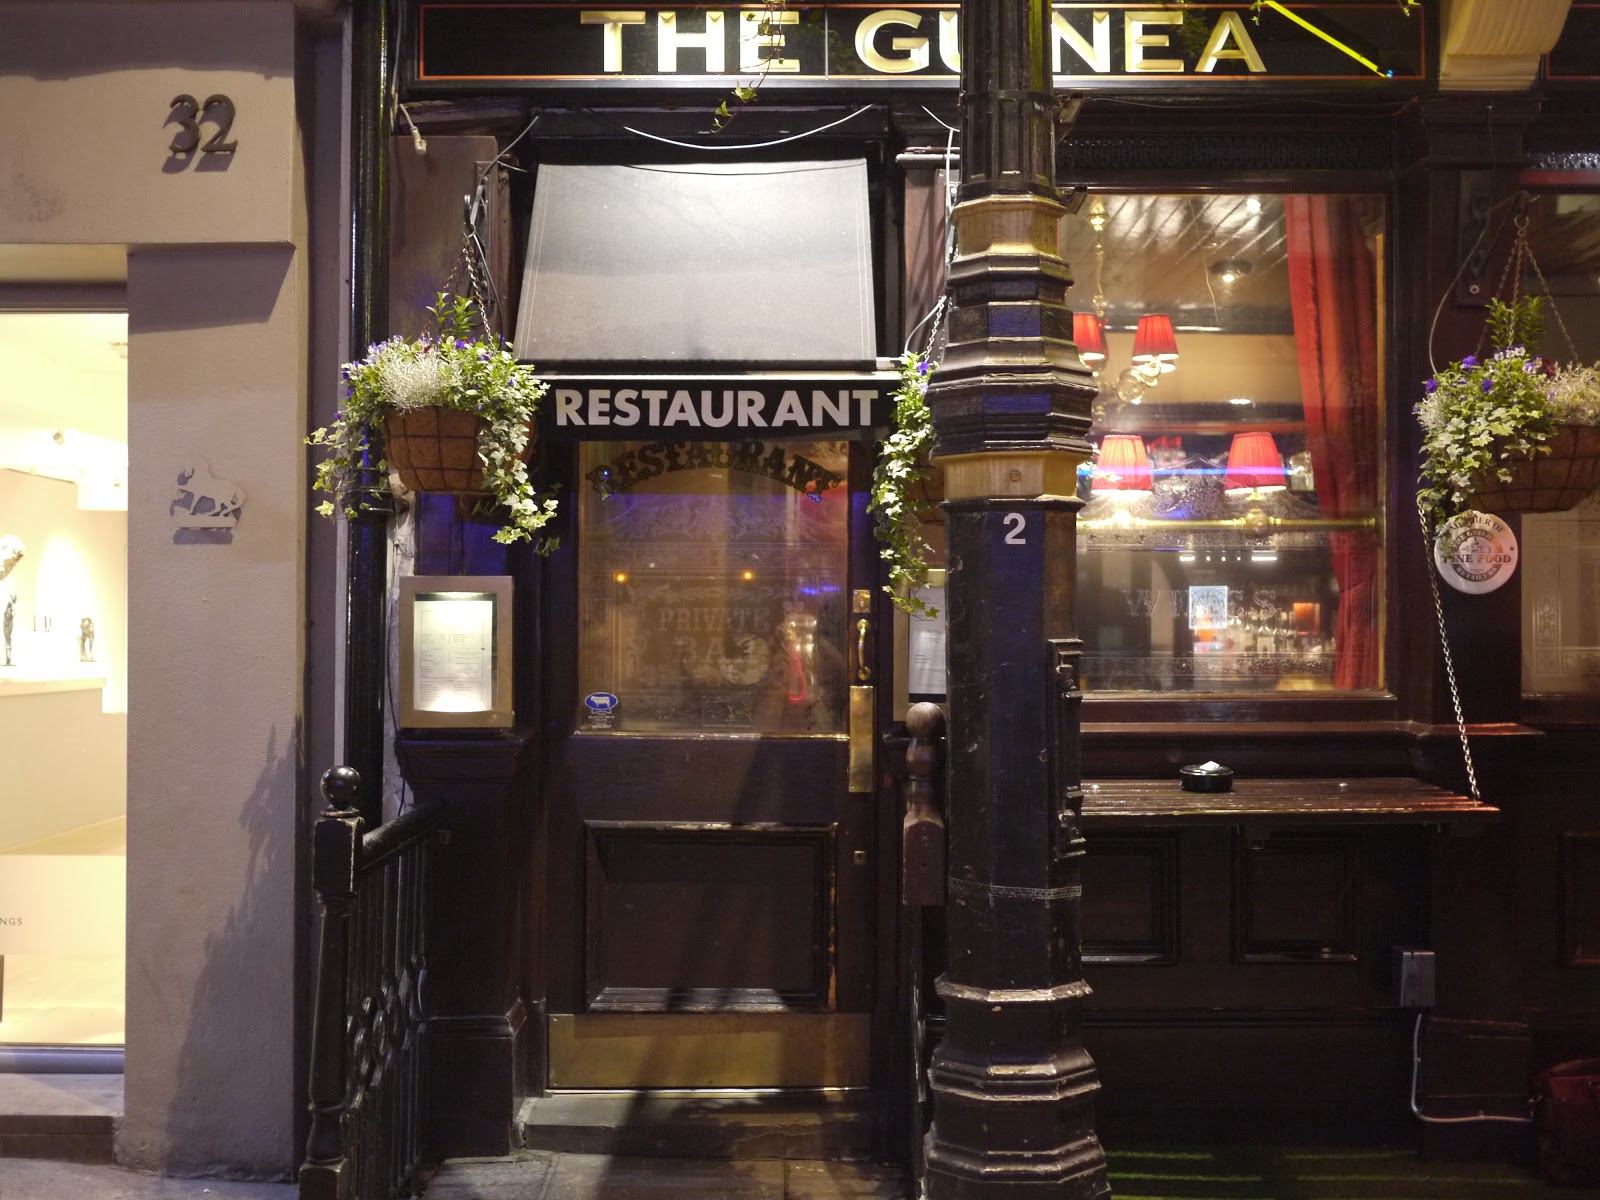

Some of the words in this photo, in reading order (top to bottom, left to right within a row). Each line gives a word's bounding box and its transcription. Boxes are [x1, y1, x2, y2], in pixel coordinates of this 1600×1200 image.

[580, 10, 800, 73] THE
[855, 9, 1267, 73] GNEA
[169, 94, 238, 152] 32
[555, 389, 878, 427] RESTAURANT
[585, 441, 843, 502] RESTAURANT
[1003, 512, 1026, 544] 2
[1450, 515, 1491, 531] MBER
[1476, 554, 1512, 563] FOOD
